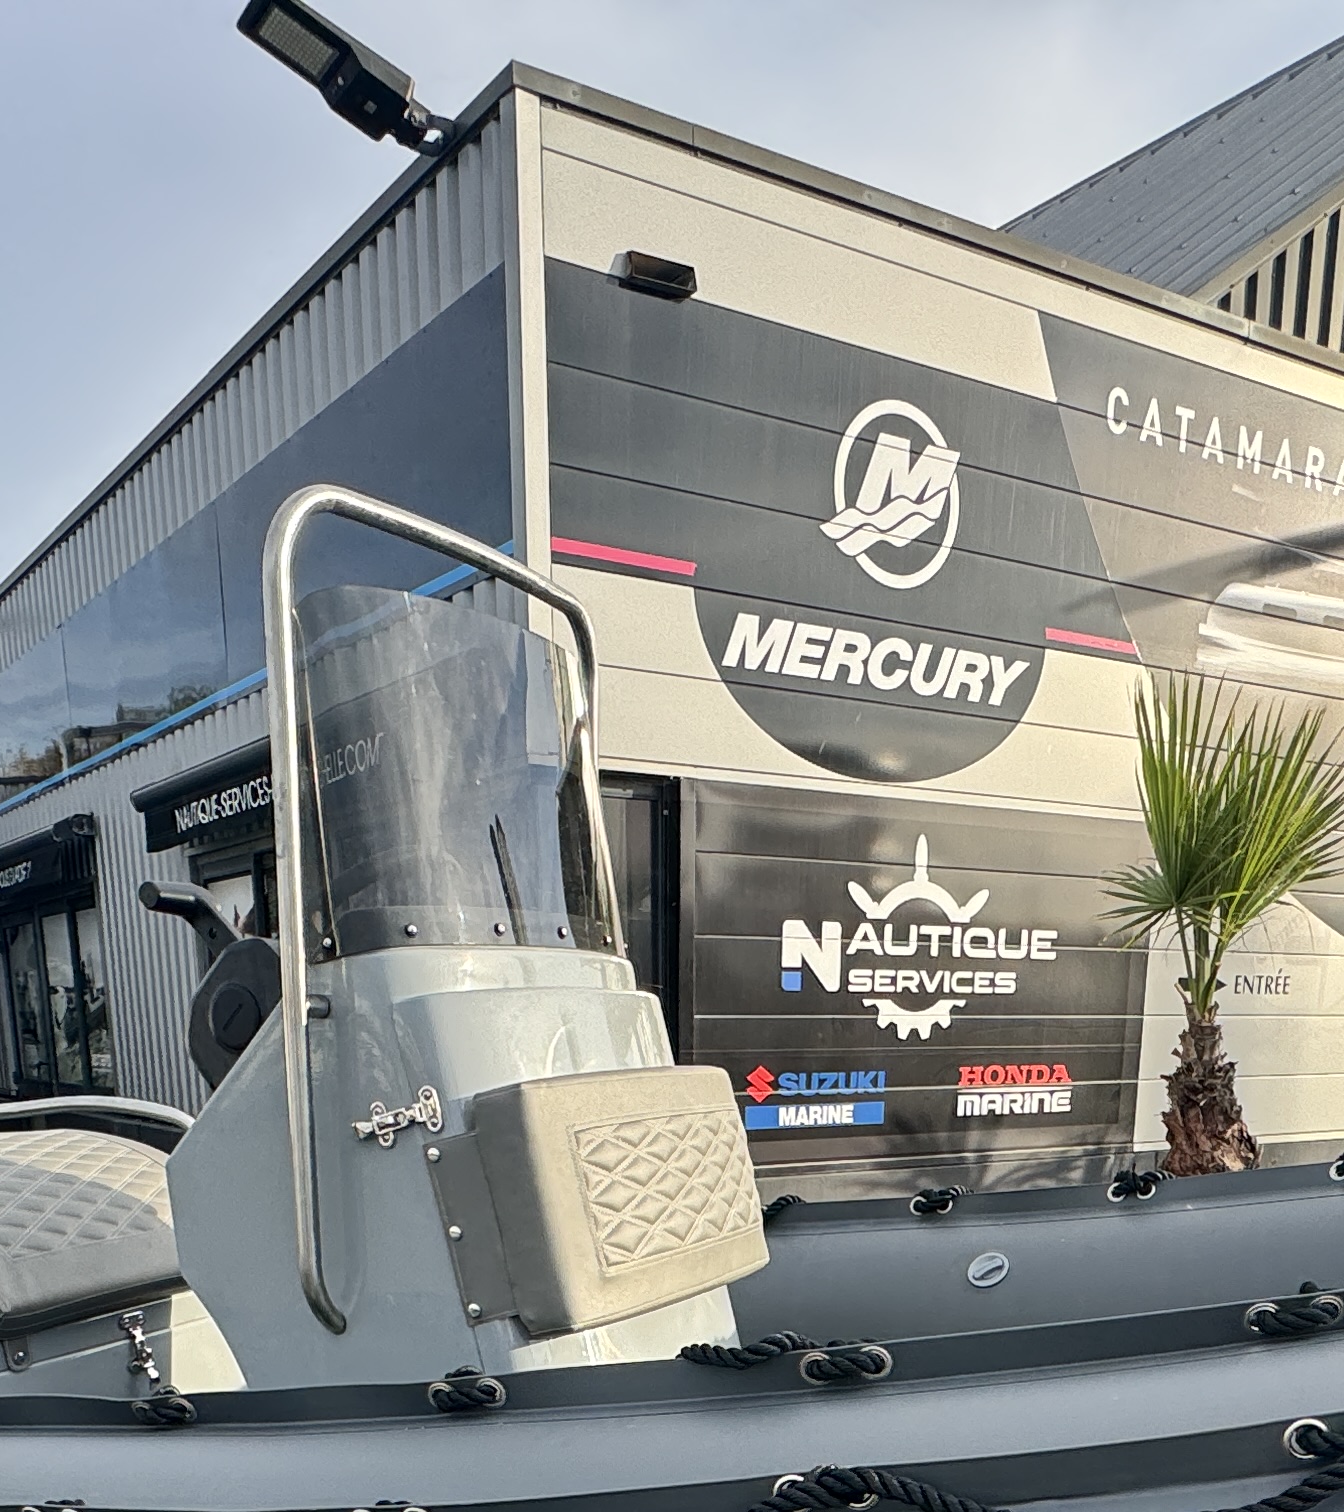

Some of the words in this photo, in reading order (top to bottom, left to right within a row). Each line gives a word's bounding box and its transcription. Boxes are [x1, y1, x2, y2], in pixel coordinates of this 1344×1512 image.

[721, 612, 1031, 707] MERCURY
[780, 919, 1058, 993] NAUTIQUE
[847, 968, 1017, 994] SERVICES
[1233, 968, 1291, 995] ENTRÉE
[777, 1070, 886, 1097] SUZUKI
[958, 1064, 1072, 1086] HONDA
[778, 1103, 855, 1126] MARINE
[956, 1090, 1072, 1117] MARINE
